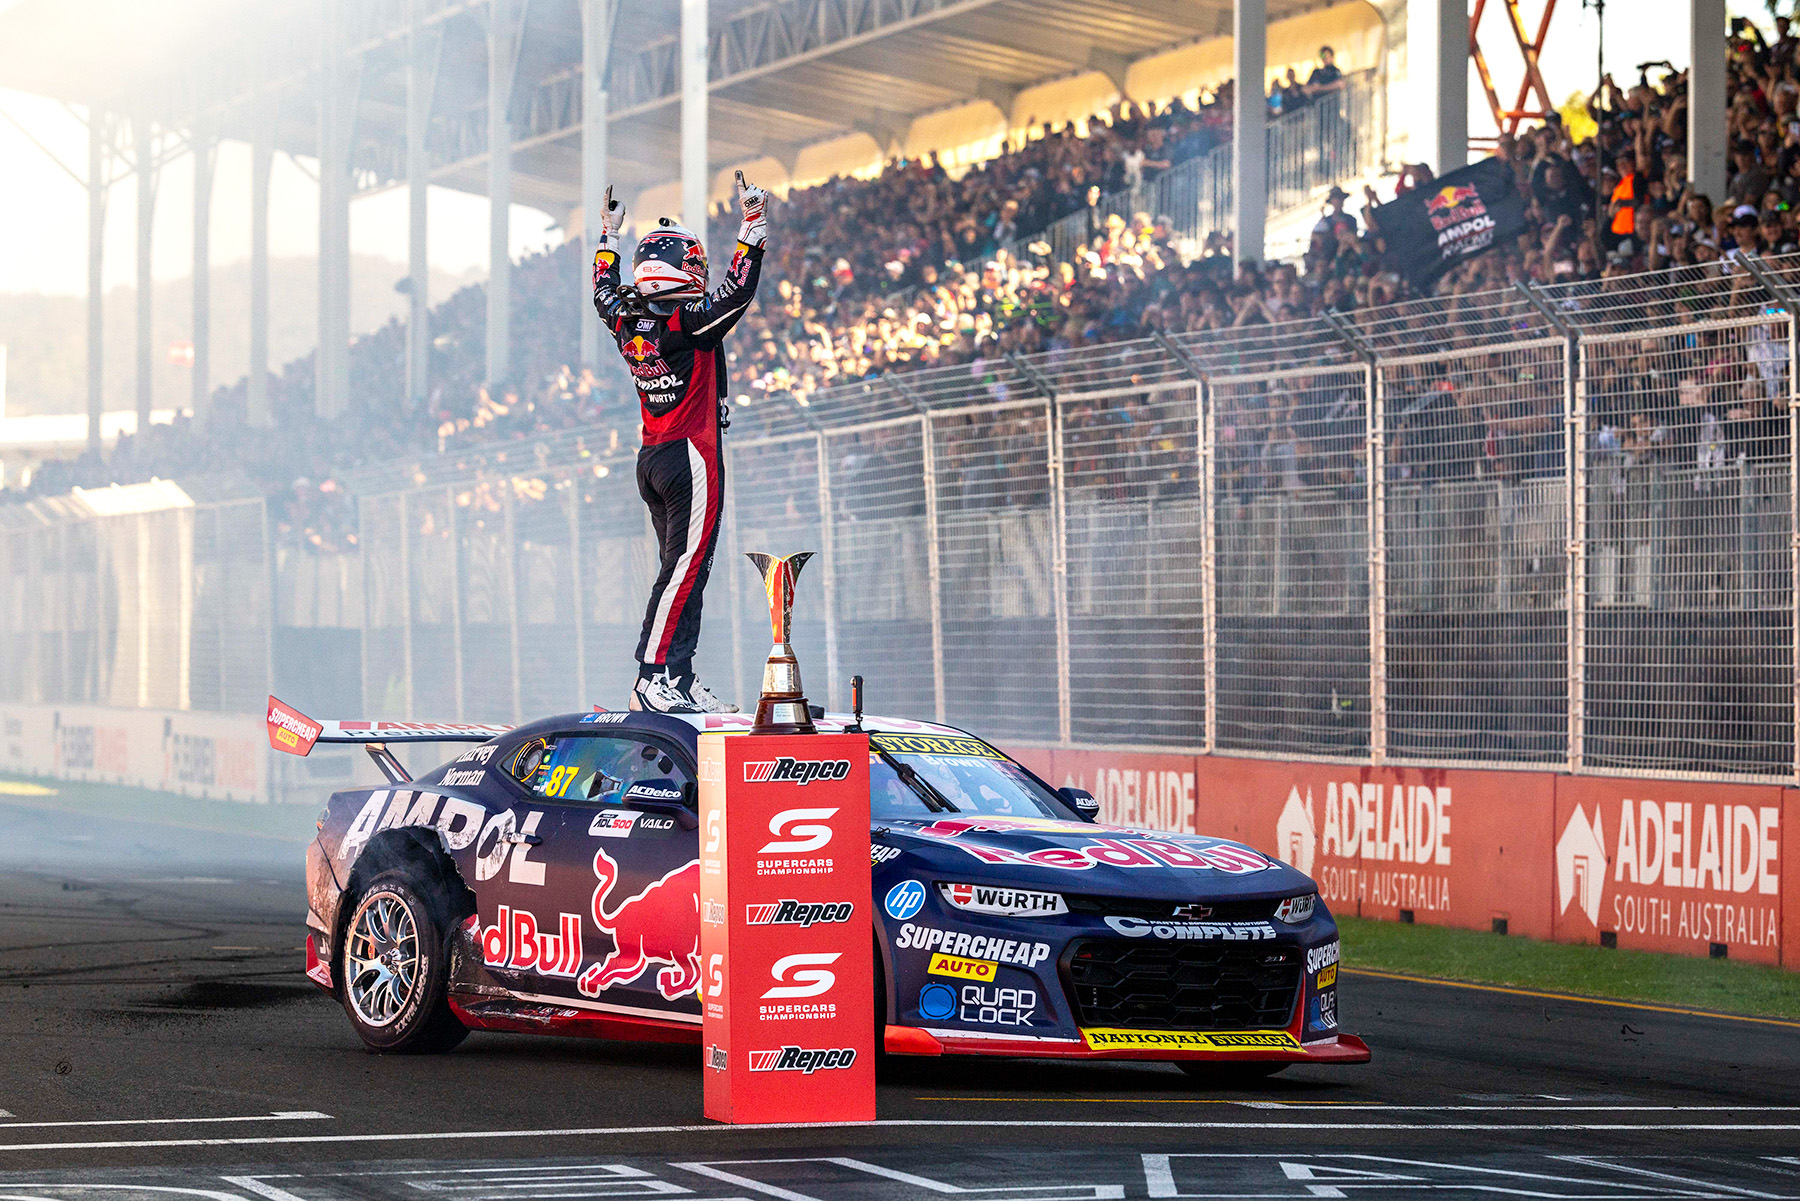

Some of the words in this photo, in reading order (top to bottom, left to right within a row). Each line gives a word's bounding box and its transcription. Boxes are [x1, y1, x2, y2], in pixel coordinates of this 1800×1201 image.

[1438, 215, 1497, 247] AMPOL
[682, 261, 697, 273] Red
[742, 258, 752, 273] Bull
[737, 271, 749, 287] Red
[636, 321, 655, 330] OMP
[642, 358, 671, 377] Bull
[268, 708, 317, 742] SUPERCHEAP
[593, 713, 630, 724] BROWN
[278, 731, 296, 745] AUTO
[871, 736, 997, 757] STORAGE
[770, 757, 851, 785] Repco
[918, 754, 986, 768] Brown
[437, 768, 486, 787] Norman
[545, 765, 580, 797] 87
[629, 785, 681, 798] ACDelco
[1096, 768, 1196, 835] ADELAIDE
[640, 818, 674, 829] VAILO
[1322, 782, 1452, 865] ADELAIDE
[945, 838, 1163, 870] Red
[1119, 838, 1282, 874] Bull
[1614, 799, 1779, 895] ADELAIDE
[757, 858, 834, 869] SUPERCARS
[757, 867, 834, 875] CHAMPIONSHIP
[1321, 865, 1367, 903] SOUTH
[1372, 870, 1451, 911] AUSTRALIA
[889, 881, 923, 919] hp
[772, 899, 854, 927] Repco
[1613, 894, 1671, 936] SOUTH
[1678, 900, 1778, 947] AUSTRALIA
[1103, 915, 1277, 940] COMPLETE
[510, 909, 583, 977] Bull
[896, 923, 1051, 968] SUPERCHEAP
[935, 959, 989, 976] AUTO
[1318, 969, 1335, 984] AUTO
[961, 985, 1037, 1010] QUAD
[759, 1004, 836, 1013] SUPERCARS
[759, 1012, 836, 1021] CHAMPIONSHIP
[960, 1005, 1035, 1027] LOCK
[1090, 1031, 1208, 1046] NATIONAL
[1212, 1034, 1294, 1047] STORAGE
[774, 1045, 857, 1074] Repco
